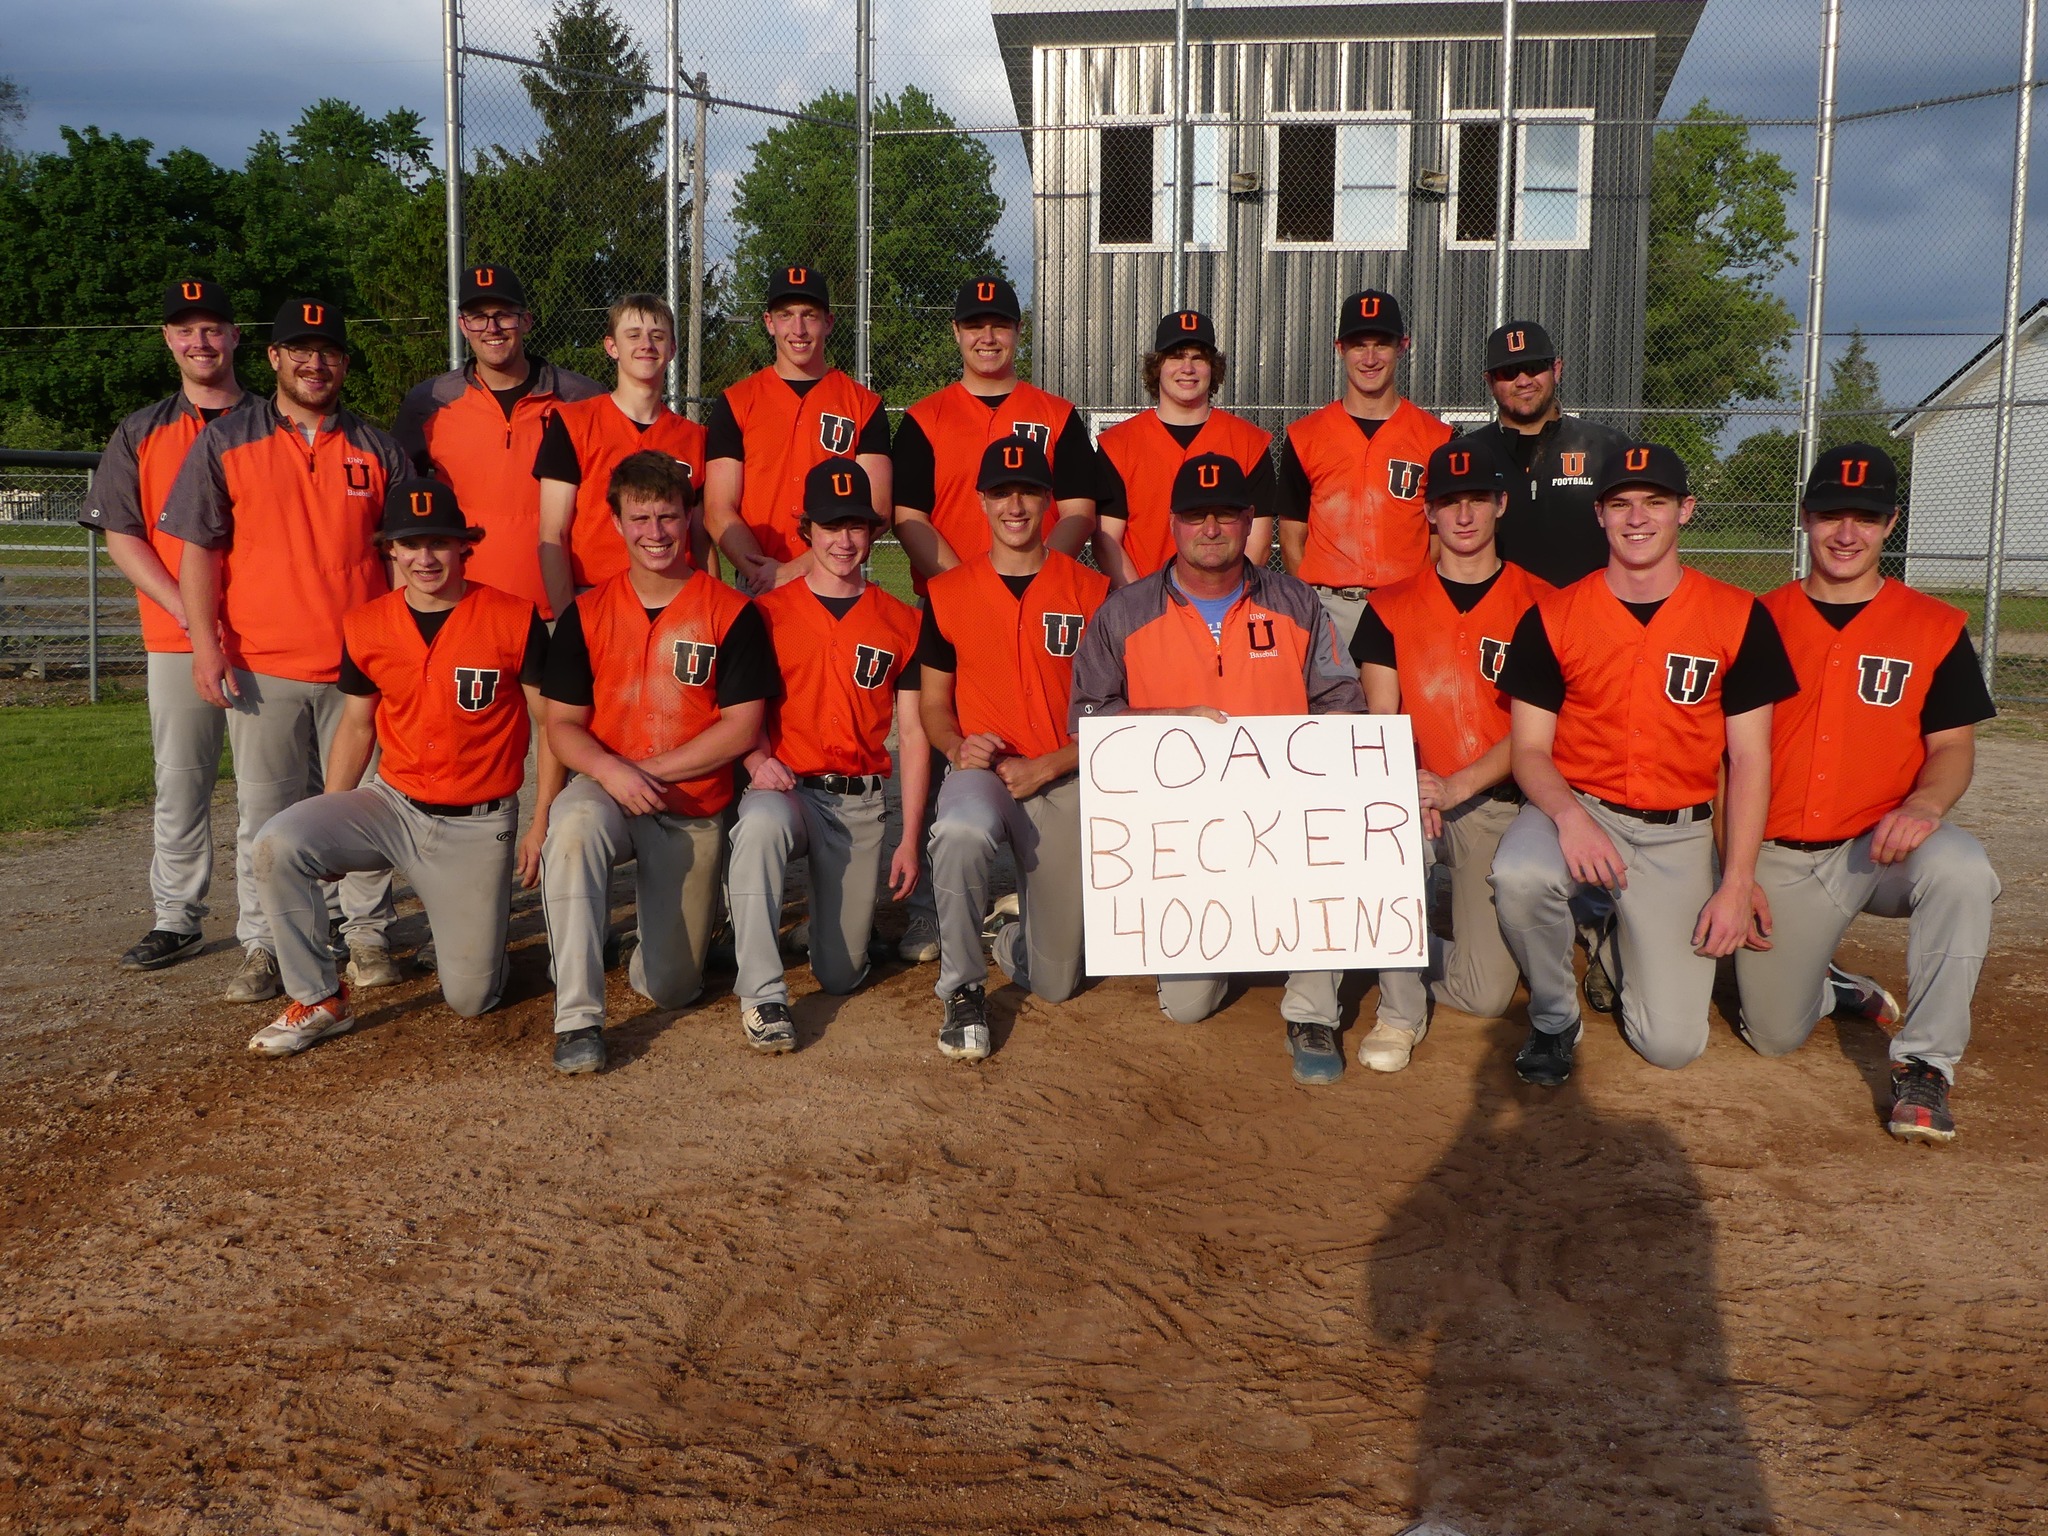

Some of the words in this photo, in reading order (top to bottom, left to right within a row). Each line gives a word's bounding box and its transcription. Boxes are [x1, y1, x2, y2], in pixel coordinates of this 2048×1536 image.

[476, 269, 493, 286] U
[788, 268, 806, 284] U
[182, 283, 201, 300] U
[978, 283, 995, 301] U
[303, 304, 323, 325] U
[1361, 298, 1380, 317] U
[1180, 314, 1197, 330] U
[1508, 331, 1525, 351] U
[819, 413, 856, 454] U
[1003, 447, 1023, 468] U
[1449, 453, 1470, 475] U
[1560, 452, 1586, 477] U
[1626, 448, 1649, 470] U
[343, 464, 370, 490] U
[1198, 465, 1219, 487] U
[1388, 459, 1426, 500] U
[1551, 477, 1594, 487] FOOTBALL
[1842, 460, 1868, 486] U
[832, 474, 852, 496] U
[410, 492, 432, 516] U
[1249, 613, 1266, 621] Ubly
[1043, 613, 1084, 657] U
[1247, 619, 1276, 651] U
[672, 640, 716, 686] U
[1249, 649, 1278, 659] Baseball
[854, 645, 894, 690] U
[1666, 653, 1718, 704] U
[455, 668, 500, 711] U
[1858, 655, 1913, 707] U
[1089, 720, 1390, 794] COACH
[1089, 801, 1409, 890] BECKER
[1113, 896, 1232, 967] 400
[1251, 895, 1425, 957] WINS!
